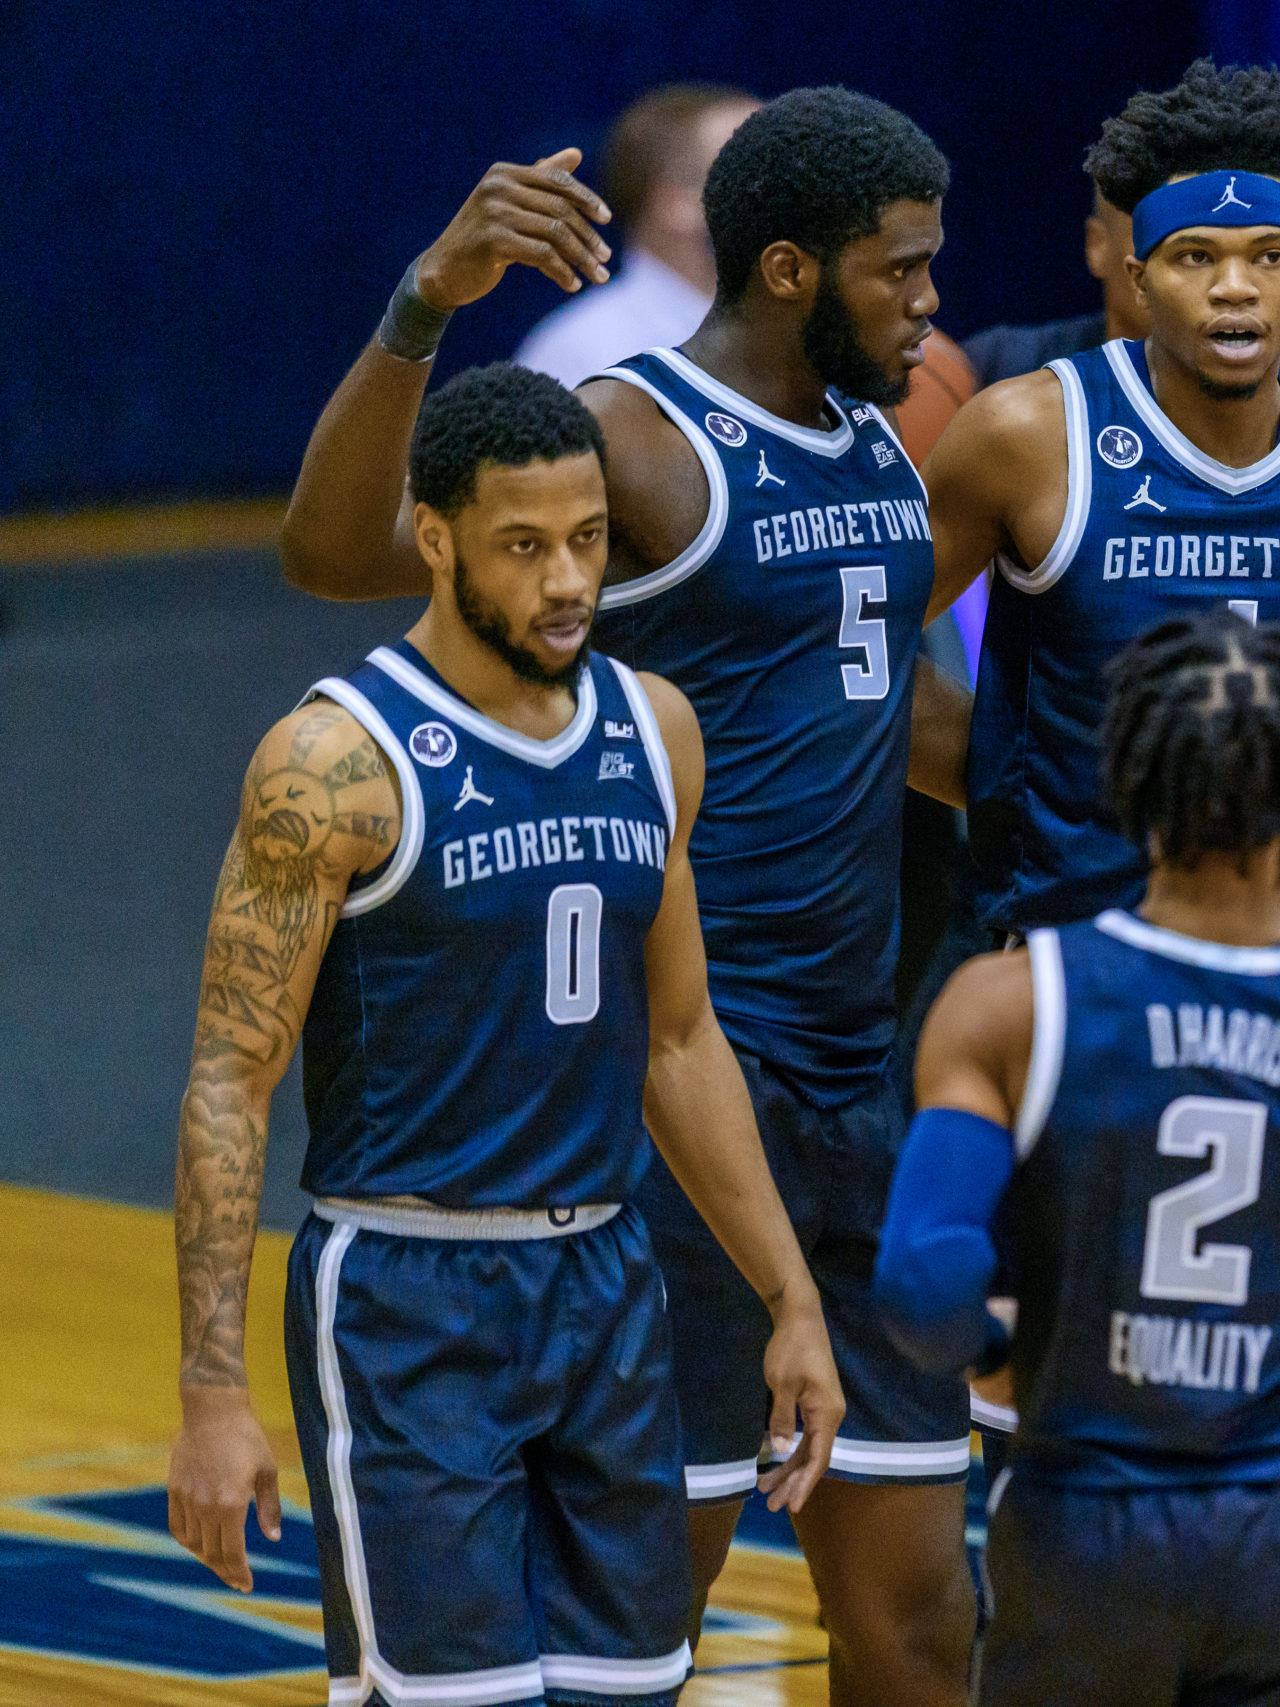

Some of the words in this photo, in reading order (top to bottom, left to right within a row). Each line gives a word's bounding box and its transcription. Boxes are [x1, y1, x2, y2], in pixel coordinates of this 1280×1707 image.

[753, 499, 933, 563] GEORGETOWN
[839, 565, 890, 700] 5
[605, 720, 634, 735] BLM
[443, 816, 666, 889] GEORGETOWN
[545, 882, 603, 1026] 0
[1139, 1094, 1269, 1306] 2
[1107, 1310, 1273, 1394] EQUALITY
